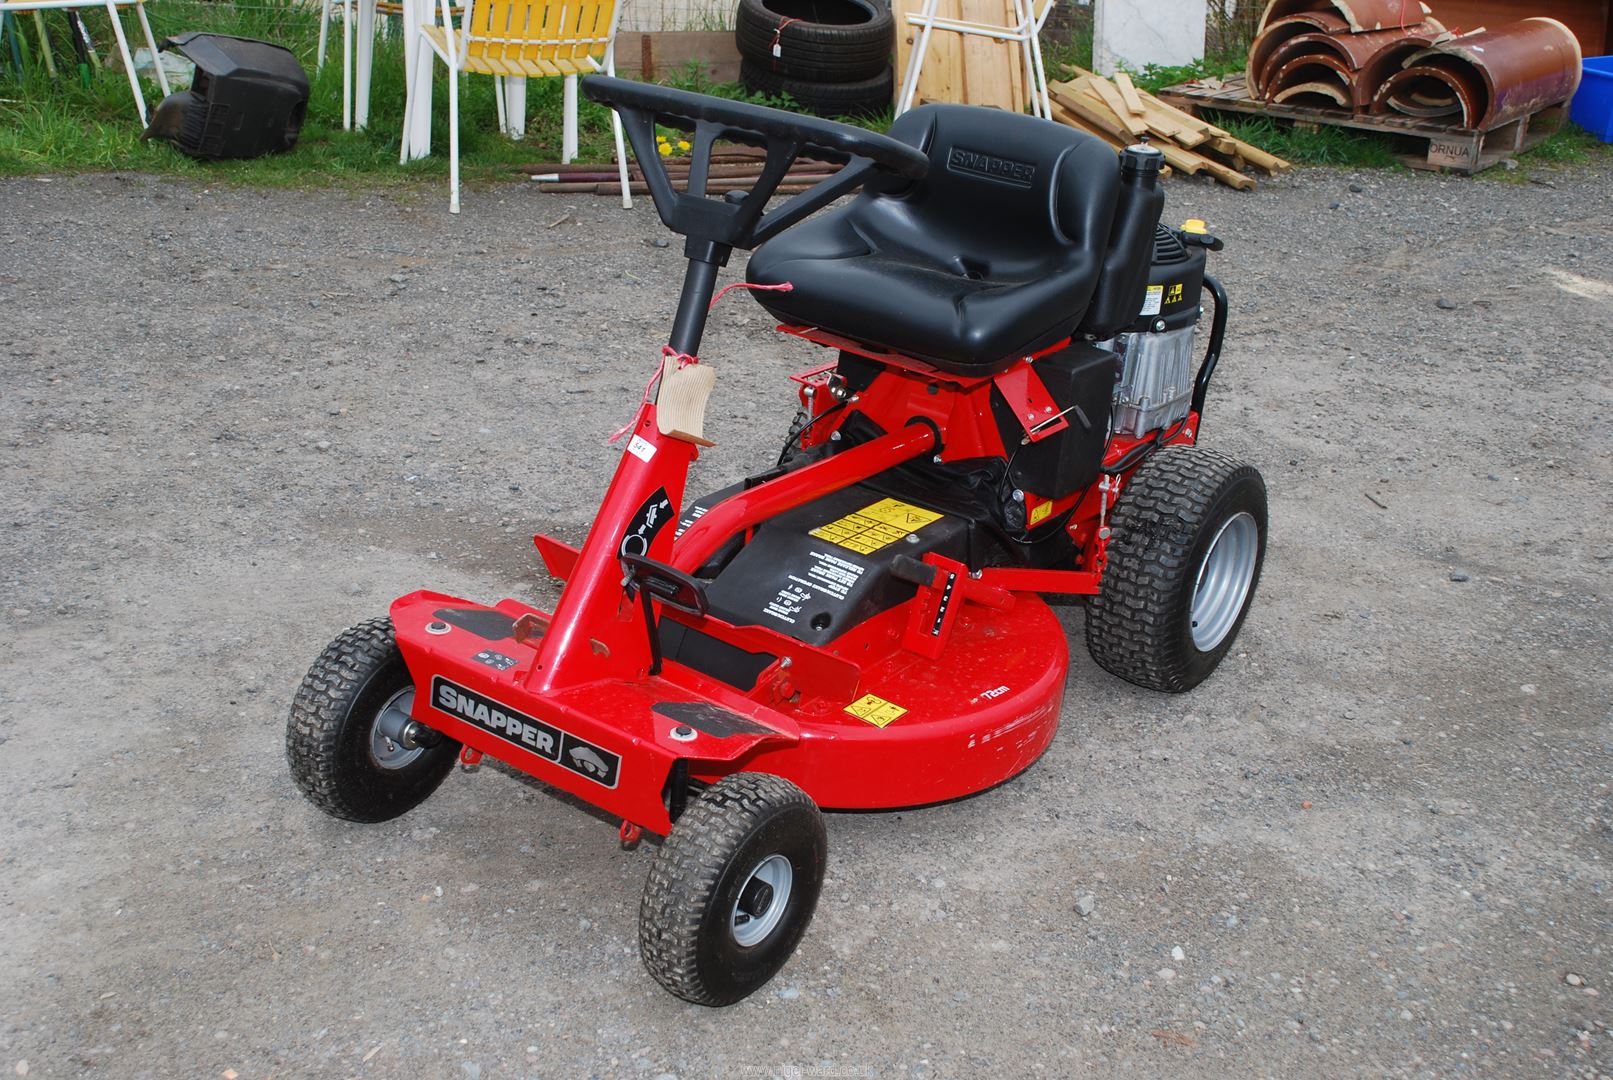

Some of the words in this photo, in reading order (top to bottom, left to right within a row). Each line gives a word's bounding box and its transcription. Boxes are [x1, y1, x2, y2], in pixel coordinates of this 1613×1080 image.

[1429, 143, 1470, 158] ORNUA
[951, 149, 1036, 181] SNAPPER
[980, 685, 1010, 700] 72cm
[438, 684, 554, 754] SNAPPER
